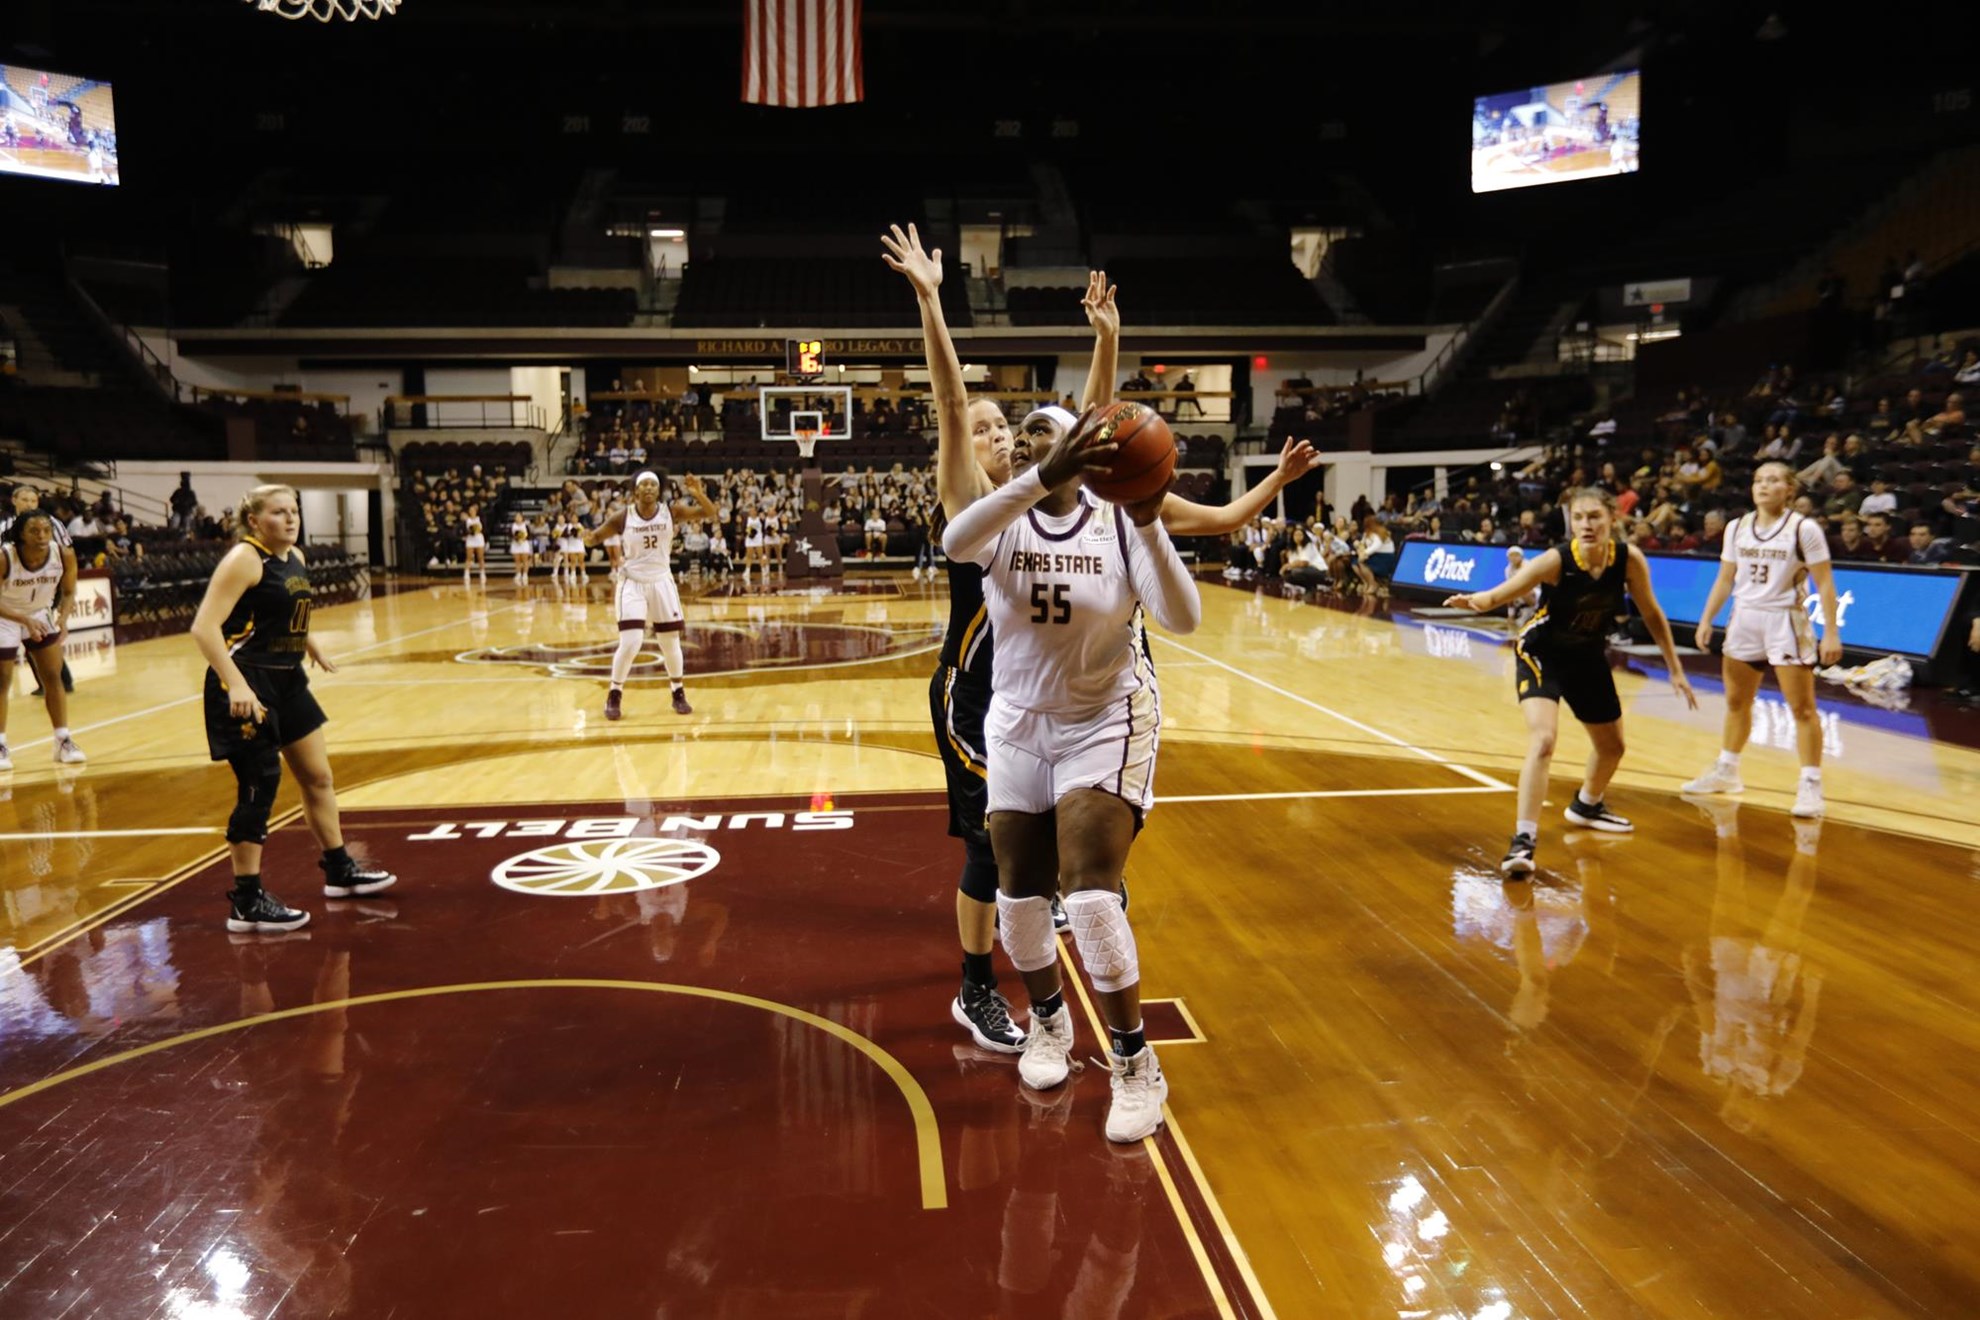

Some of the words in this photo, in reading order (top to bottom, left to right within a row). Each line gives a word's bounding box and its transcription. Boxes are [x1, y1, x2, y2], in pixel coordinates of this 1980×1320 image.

[697, 340, 767, 353] RICHARD
[847, 340, 904, 353] LEGACY
[643, 535, 658, 549] 32
[1010, 551, 1051, 573] TEXAS
[1055, 556, 1103, 574] STATE
[1439, 554, 1476, 582] Frost
[1031, 583, 1072, 625] 55
[406, 817, 641, 841] BELT
[660, 810, 855, 831] SUN
